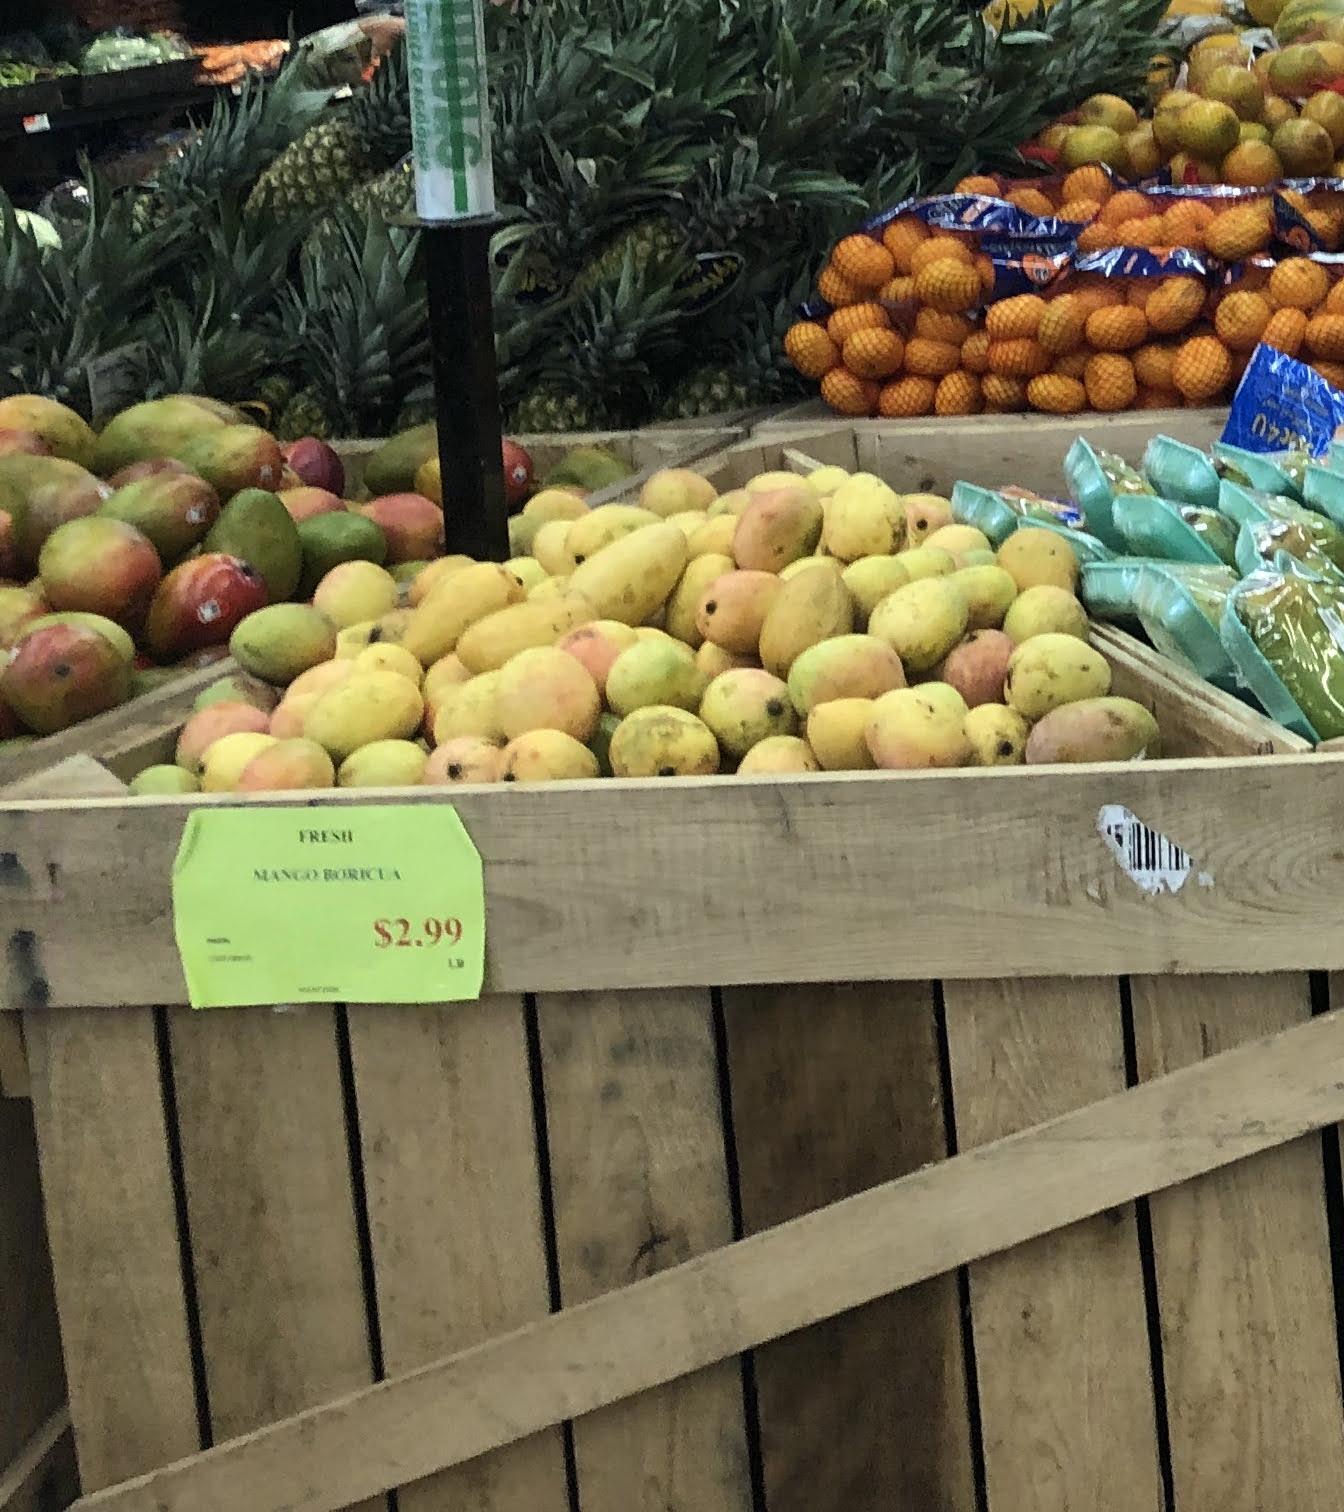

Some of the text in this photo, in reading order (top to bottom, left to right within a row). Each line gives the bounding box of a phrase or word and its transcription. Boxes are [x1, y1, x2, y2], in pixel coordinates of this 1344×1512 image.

[299, 829, 354, 843] FRESH
[252, 867, 402, 882] MANGO BORICUA
[373, 917, 463, 949] $2.99
